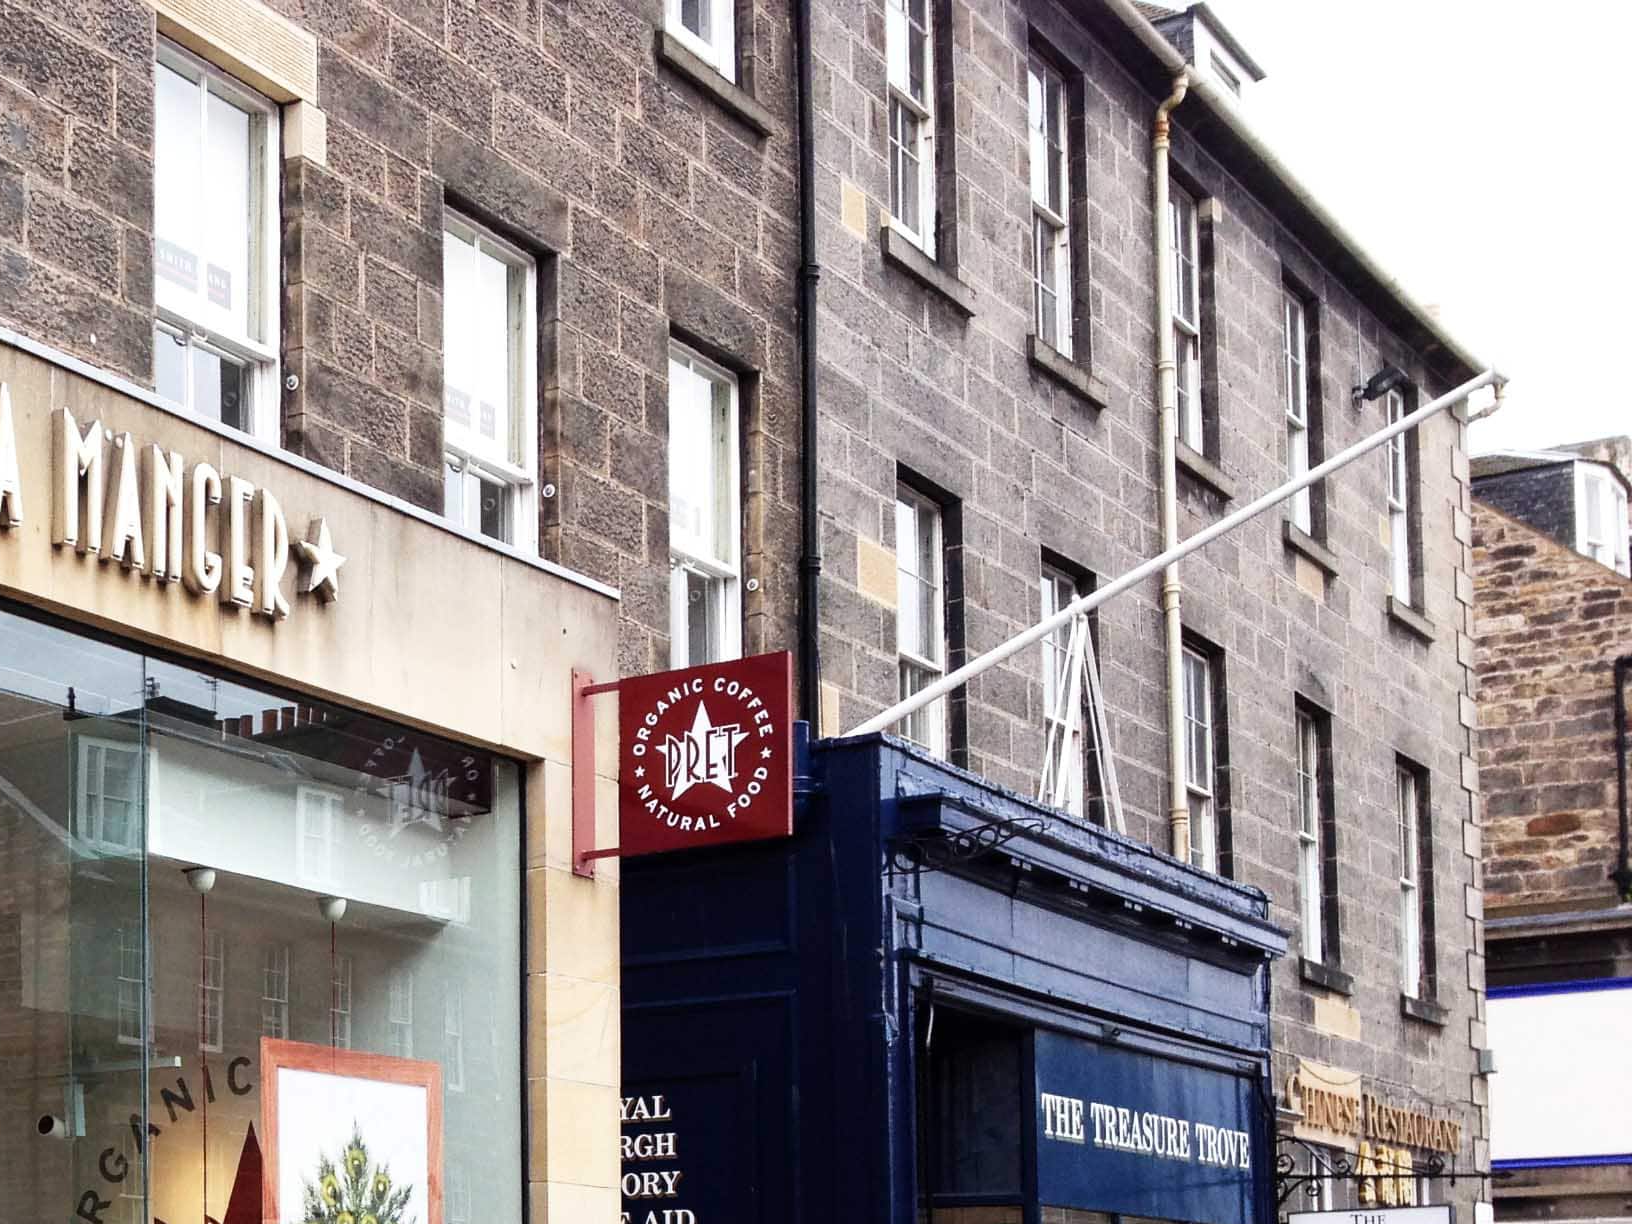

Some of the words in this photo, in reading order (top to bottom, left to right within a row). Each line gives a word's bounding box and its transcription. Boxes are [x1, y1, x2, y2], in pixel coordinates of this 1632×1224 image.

[51, 408, 290, 621] MANGER
[632, 678, 704, 757] ORGANIC
[713, 677, 773, 738] COFFEE
[665, 724, 740, 788] PRET
[638, 784, 721, 831] NATURAL
[726, 766, 768, 819] FOOD
[1041, 1093, 1084, 1139] THE
[1090, 1102, 1190, 1158] TREASURE
[1195, 1123, 1250, 1169] TROVE
[1365, 1095, 1461, 1153] RESTAURANT
